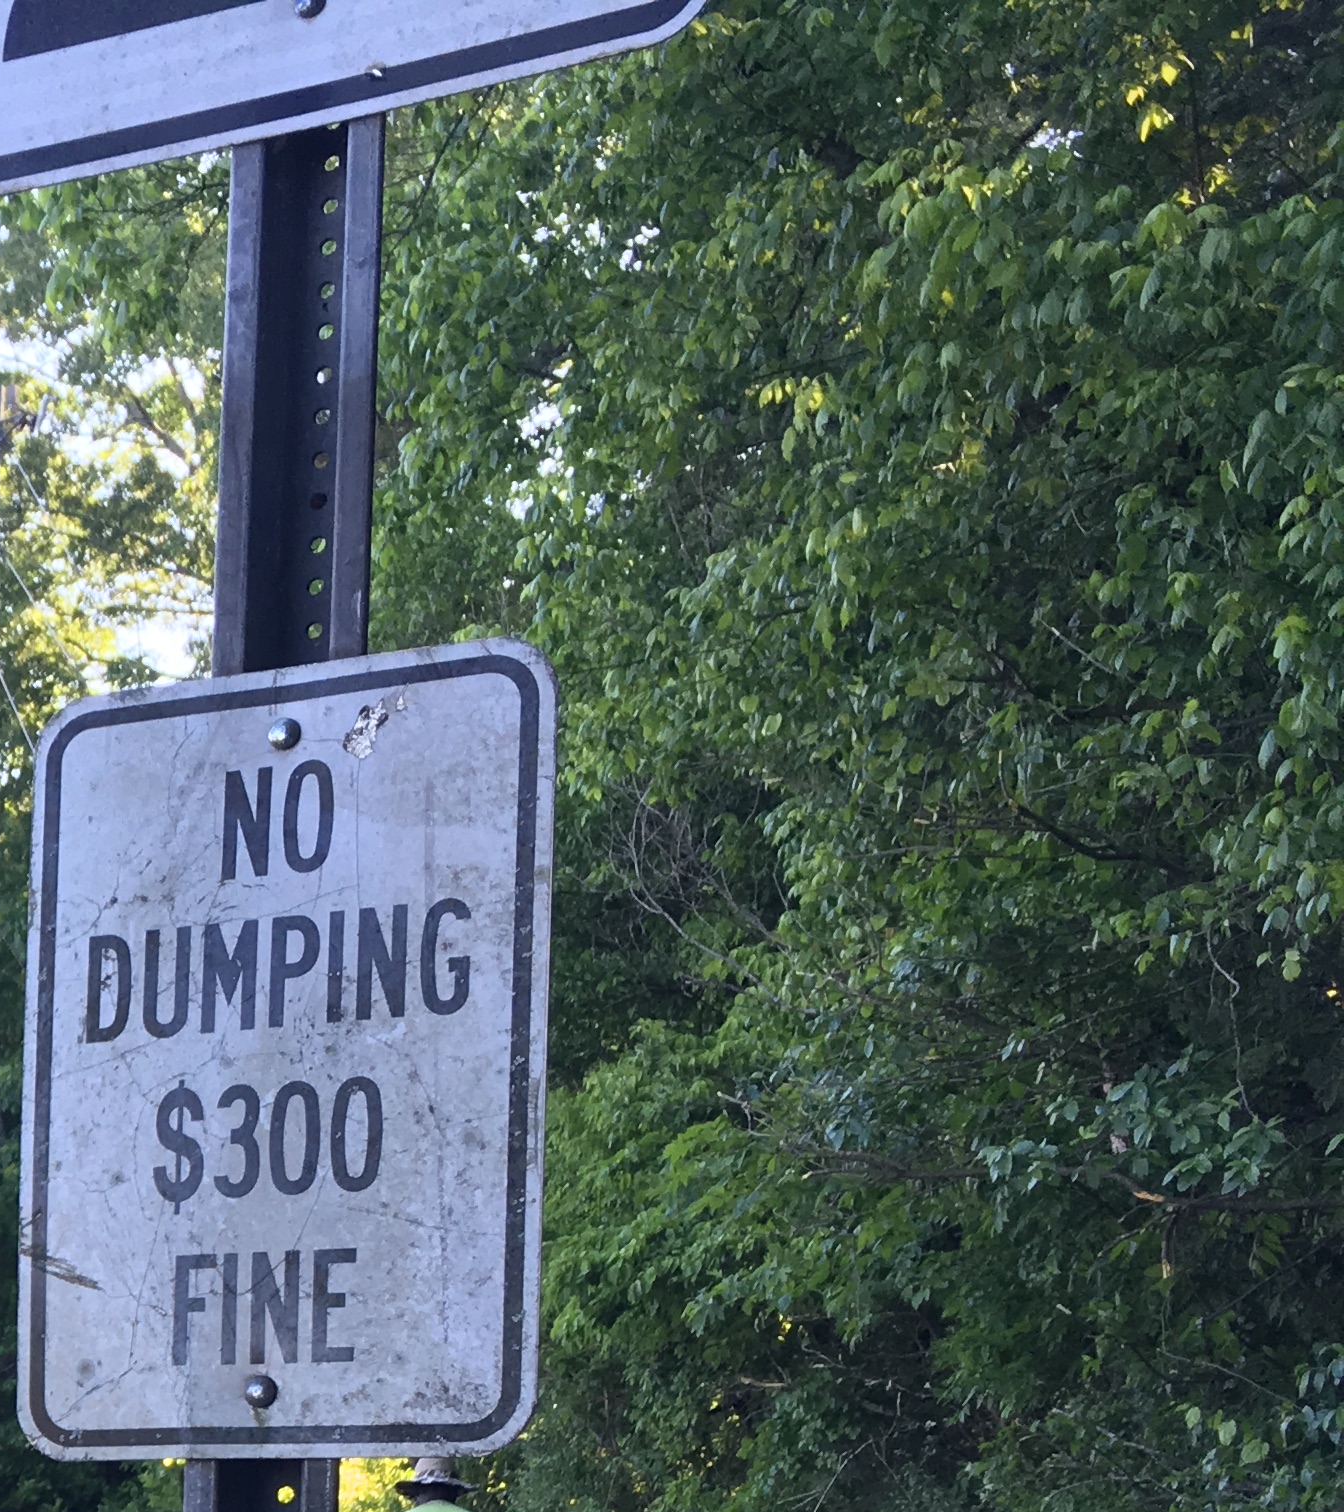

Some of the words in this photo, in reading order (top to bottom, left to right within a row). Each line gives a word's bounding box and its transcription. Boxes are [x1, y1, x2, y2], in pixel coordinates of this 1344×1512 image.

[220, 758, 336, 881] NO
[84, 897, 473, 1045] DUMPING
[153, 1075, 384, 1216] $300
[171, 1247, 358, 1367] FINE
